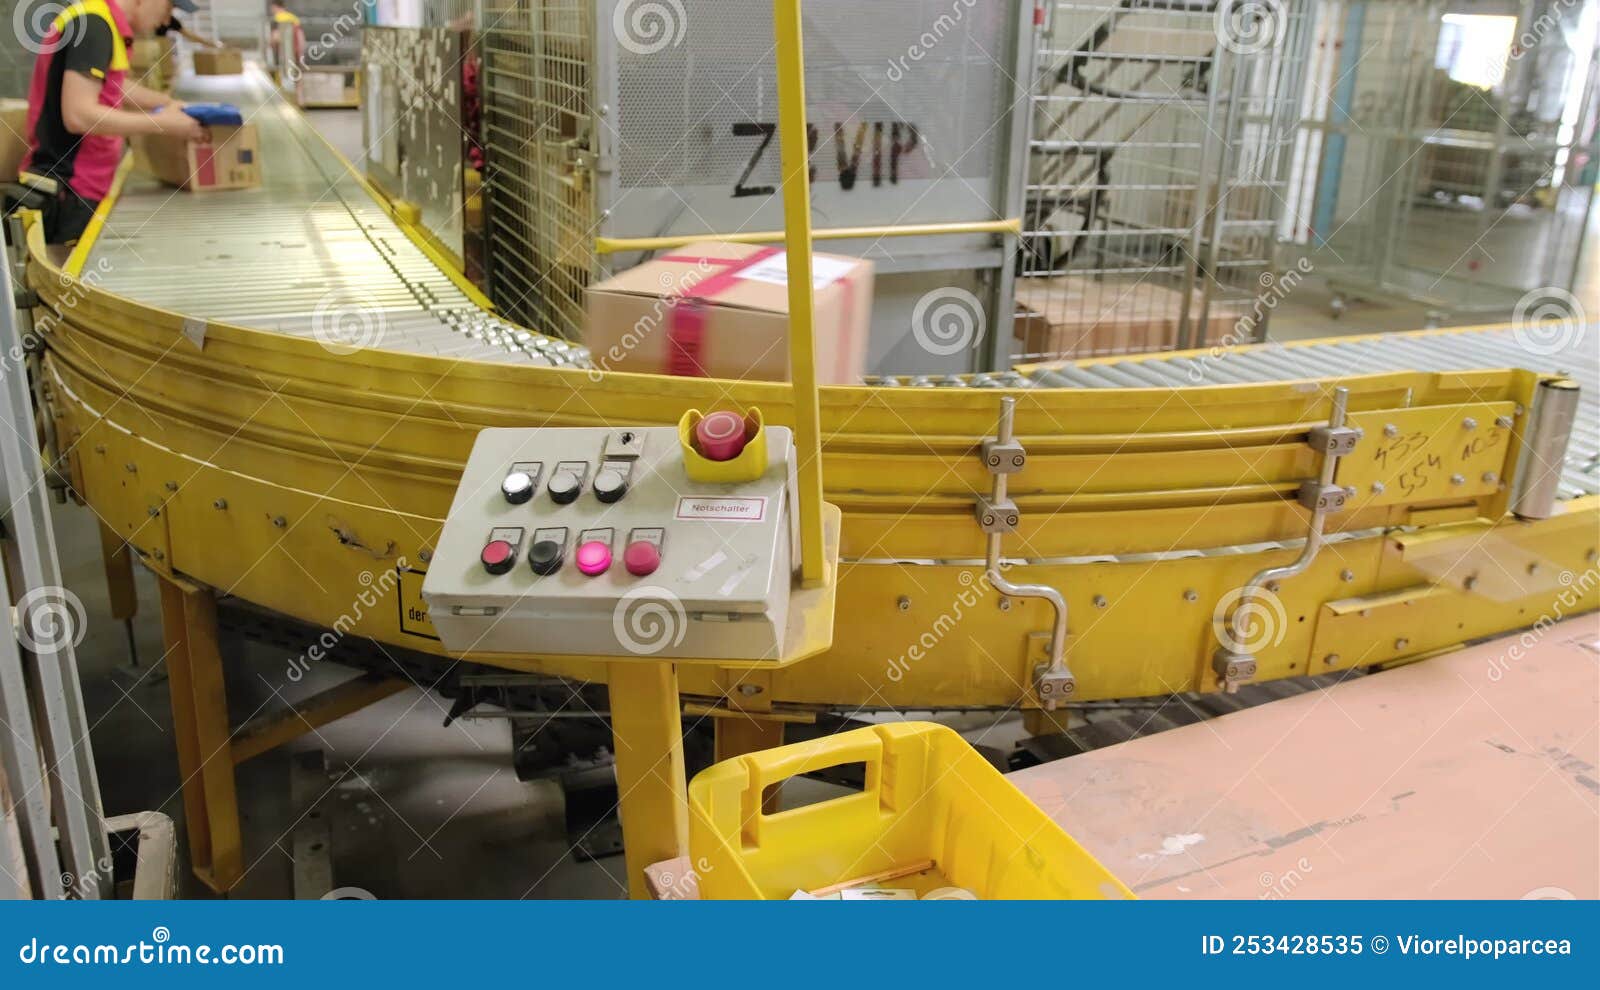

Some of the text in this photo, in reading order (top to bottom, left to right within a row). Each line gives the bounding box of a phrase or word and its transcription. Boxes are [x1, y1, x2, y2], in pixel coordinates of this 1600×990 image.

[834, 121, 918, 190] VIP
[692, 504, 750, 513] Notschalter
[409, 606, 427, 623] der
